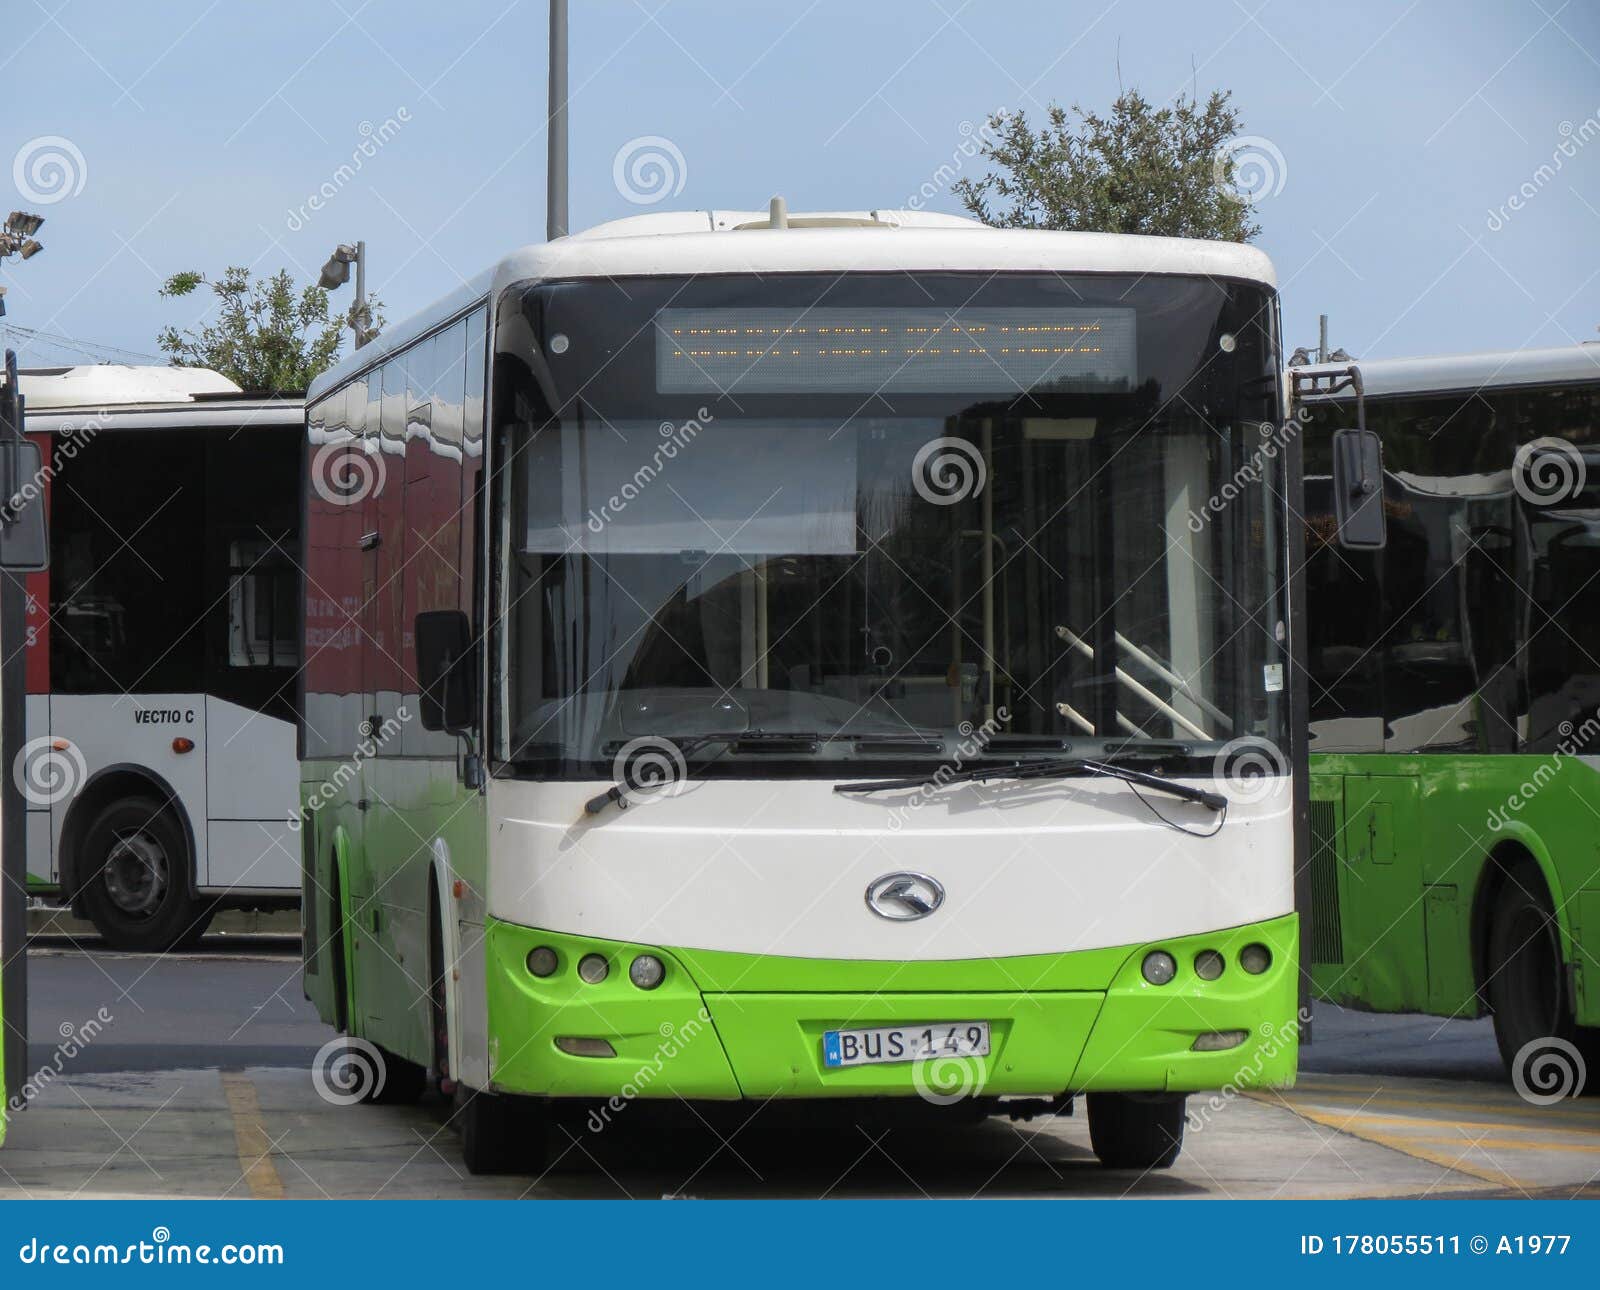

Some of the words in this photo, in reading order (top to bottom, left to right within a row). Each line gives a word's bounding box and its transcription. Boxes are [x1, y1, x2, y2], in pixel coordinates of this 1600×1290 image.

[135, 710, 181, 724] VECTIO
[185, 710, 194, 724] C
[842, 1031, 904, 1060] BUS
[921, 1026, 982, 1055] 149
